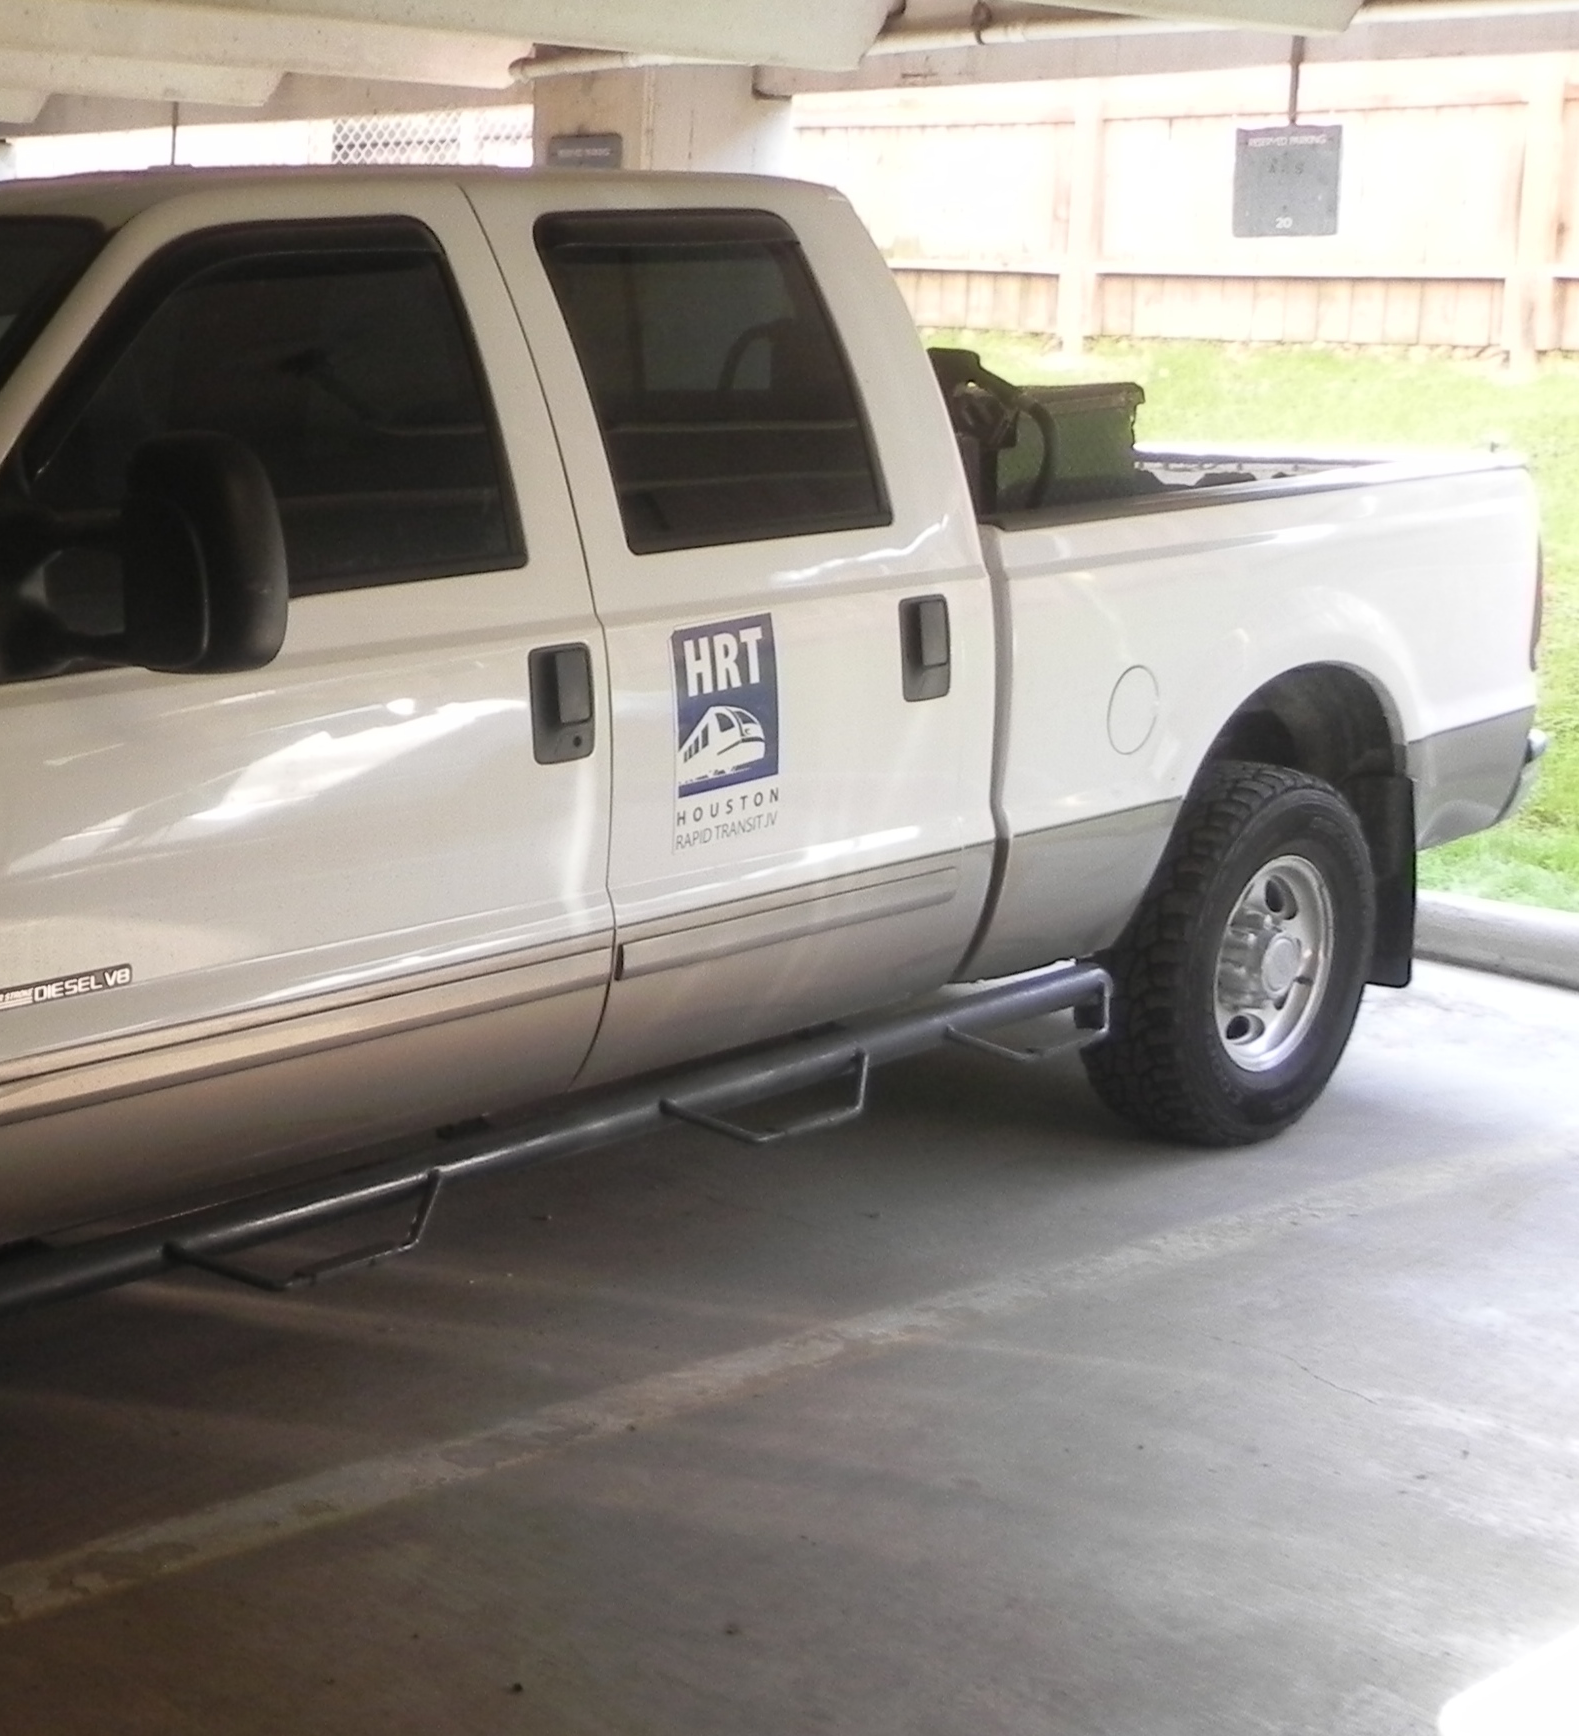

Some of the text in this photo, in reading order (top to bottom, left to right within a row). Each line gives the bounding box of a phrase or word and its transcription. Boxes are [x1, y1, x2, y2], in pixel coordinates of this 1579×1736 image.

[1275, 216, 1293, 229] 20
[682, 625, 763, 698] HRT
[676, 788, 780, 827] HOUSTON
[675, 826, 713, 850] RAPID
[714, 813, 765, 840] TRANSIT
[33, 967, 131, 1002] DIESEL V8
